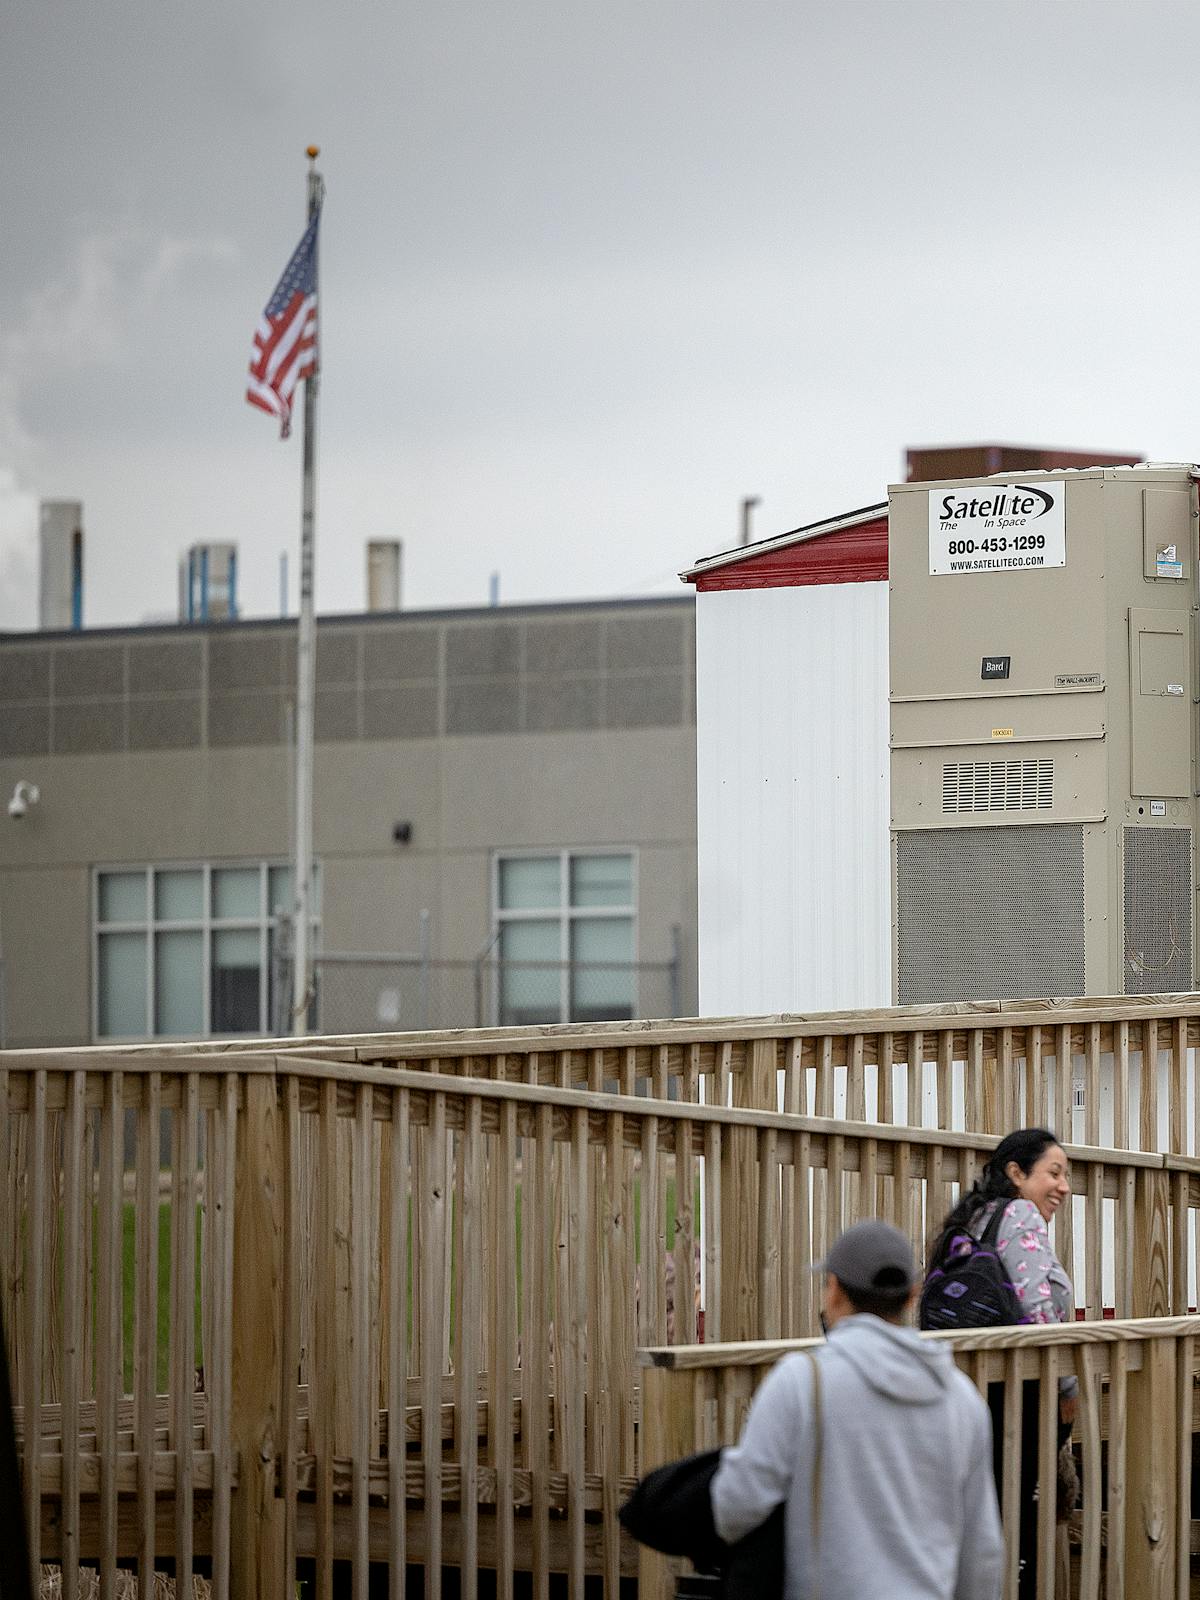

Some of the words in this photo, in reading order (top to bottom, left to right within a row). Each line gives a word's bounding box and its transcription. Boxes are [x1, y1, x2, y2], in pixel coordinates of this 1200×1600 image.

[939, 494, 1035, 520] Satellite
[939, 521, 958, 531] The
[984, 519, 994, 528] In
[997, 517, 1027, 529] Space
[948, 534, 1045, 555] 800-453-1299
[950, 556, 1044, 571] WWW.SATELLITECO.COM
[985, 661, 1004, 672] Bard
